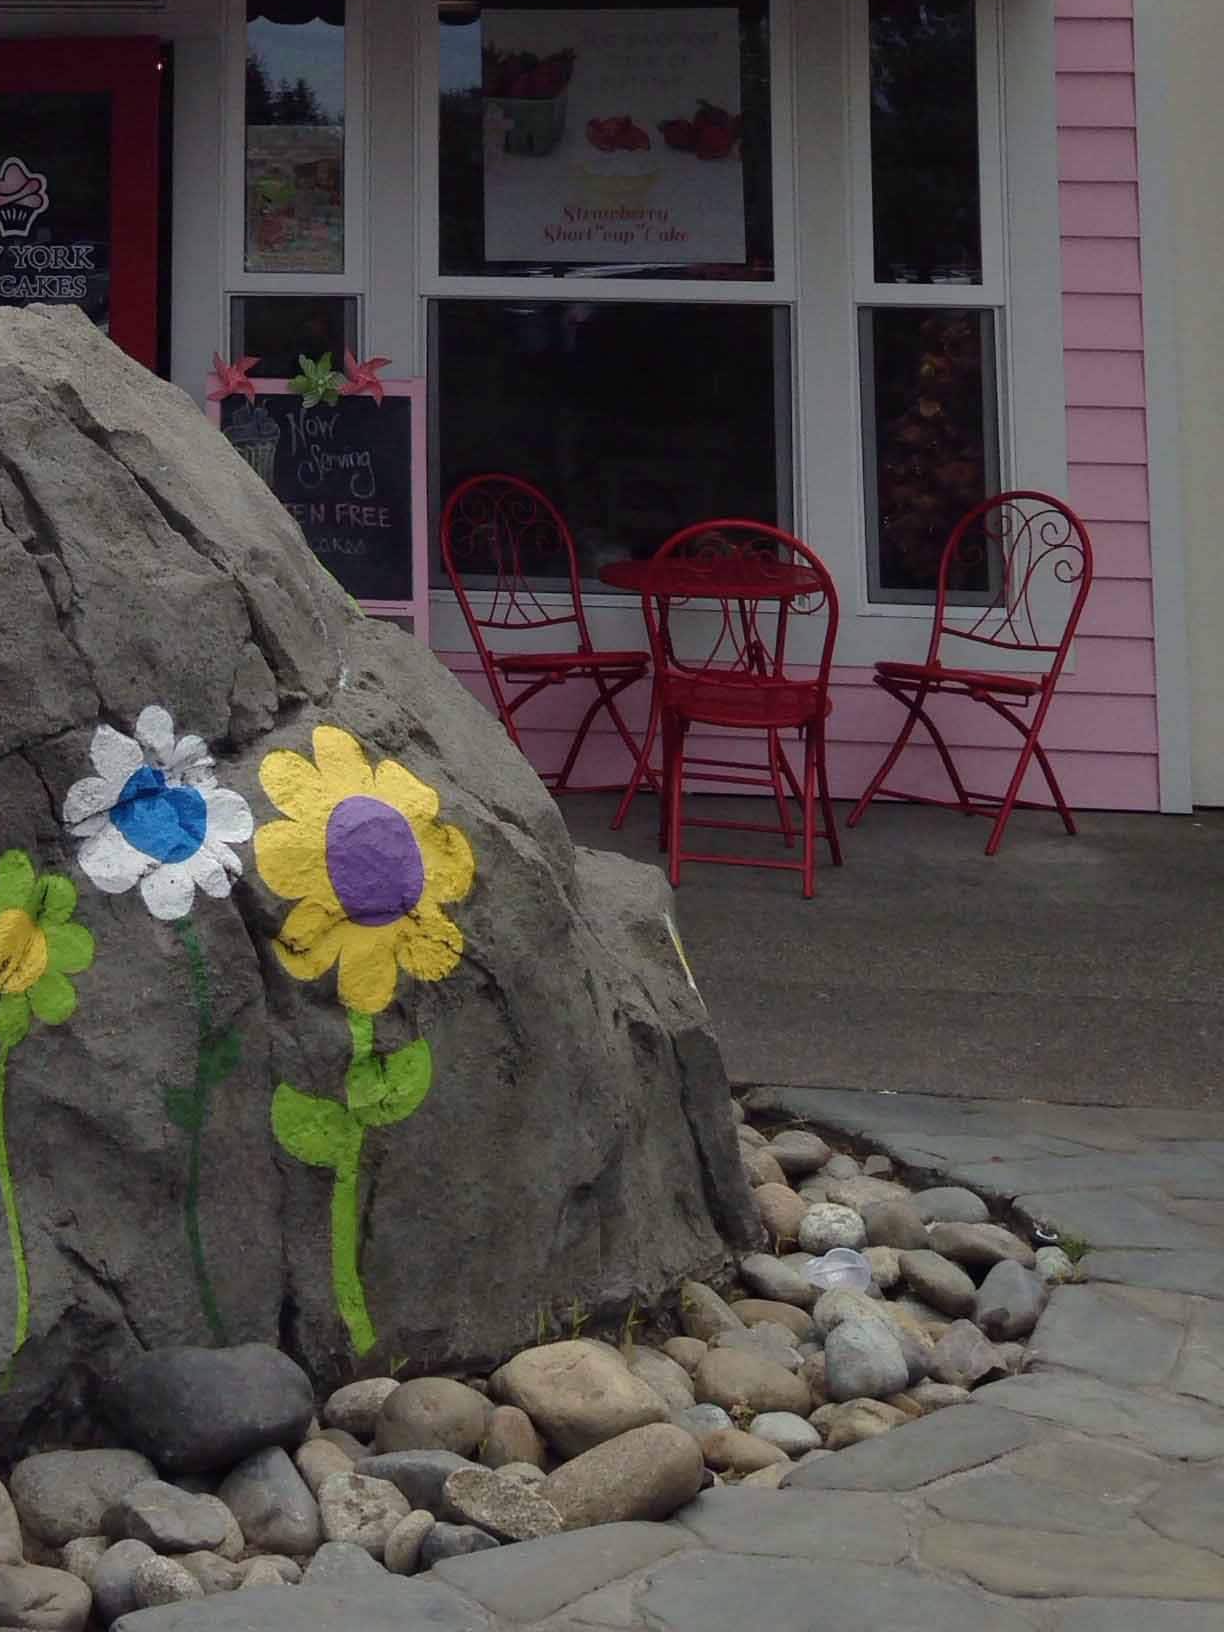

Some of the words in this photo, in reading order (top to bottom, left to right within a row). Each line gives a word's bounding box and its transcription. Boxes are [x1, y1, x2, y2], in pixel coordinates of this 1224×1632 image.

[8, 245, 95, 272] YORK
[285, 407, 341, 457] Now
[296, 441, 376, 499] Serving
[334, 502, 393, 529] FREE
